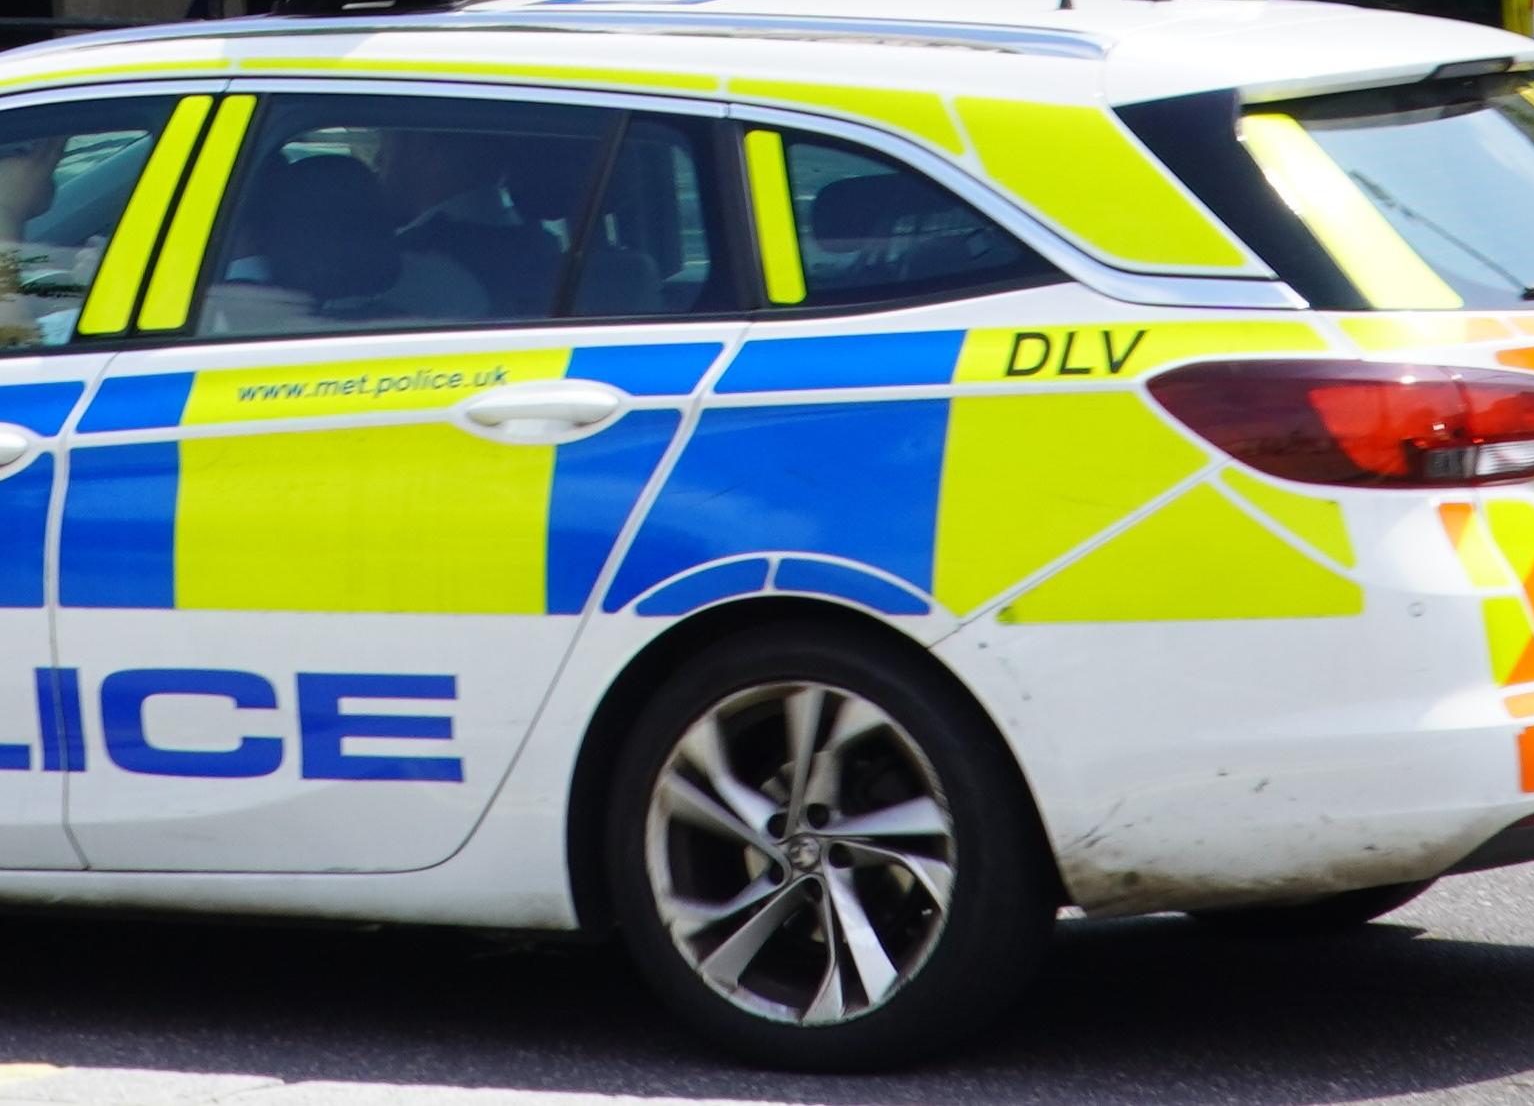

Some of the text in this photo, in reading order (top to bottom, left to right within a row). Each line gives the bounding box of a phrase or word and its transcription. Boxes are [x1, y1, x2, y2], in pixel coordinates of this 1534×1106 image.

[1005, 329, 1147, 377] DLV
[236, 364, 511, 402] www.met.police.uk
[0, 667, 465, 783] ICE
